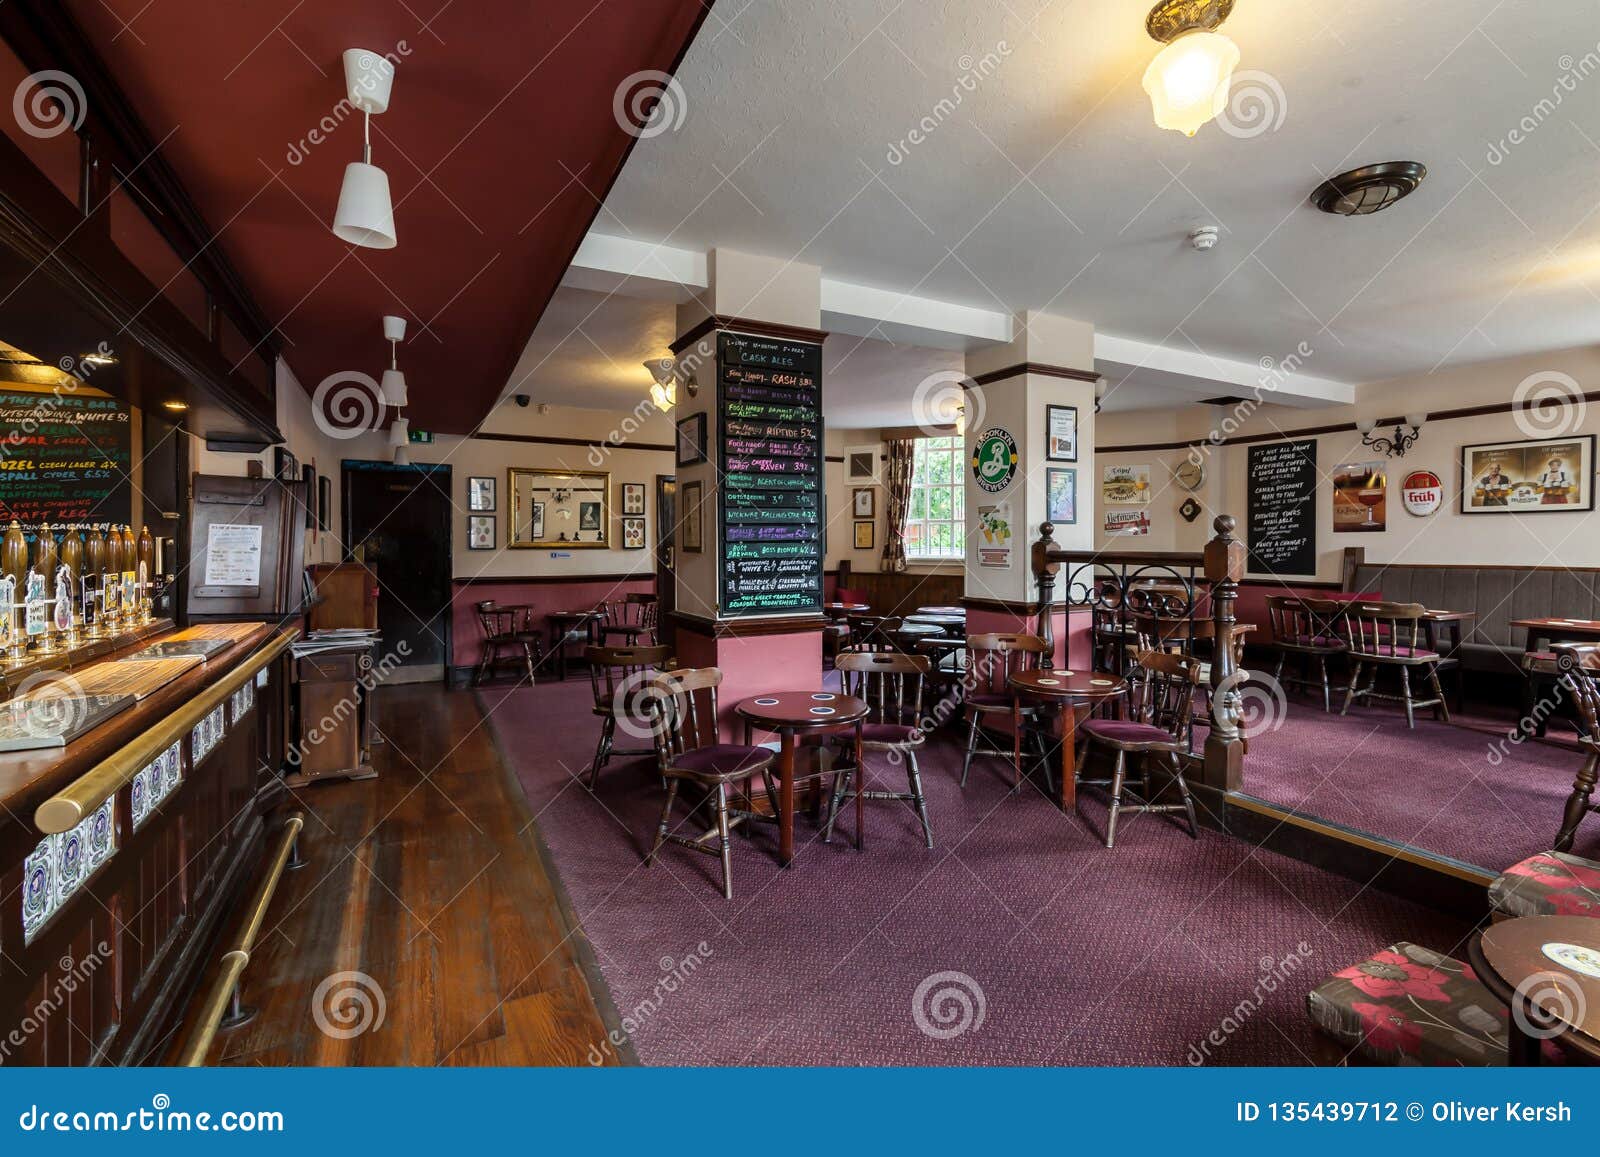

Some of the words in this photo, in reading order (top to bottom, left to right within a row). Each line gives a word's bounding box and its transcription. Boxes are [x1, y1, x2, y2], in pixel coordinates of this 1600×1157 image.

[741, 352, 767, 362] CASK
[771, 356, 793, 366] ALES
[771, 374, 797, 386] RASH
[88, 401, 117, 410] BAR
[76, 412, 116, 422] WHITE
[766, 427, 799, 438] RIPTIDE
[977, 429, 1013, 449] BROOKLYN
[0, 460, 36, 470] OZEL
[39, 461, 67, 469] CZECH
[69, 461, 96, 469] LAGER
[100, 461, 118, 469] 4%
[760, 463, 785, 471] RAVEN
[0, 471, 38, 481] SPALL
[43, 471, 77, 479] CYDER
[977, 473, 1012, 491] BREWERY
[0, 510, 50, 520] CRAFT
[58, 510, 88, 519] KEG
